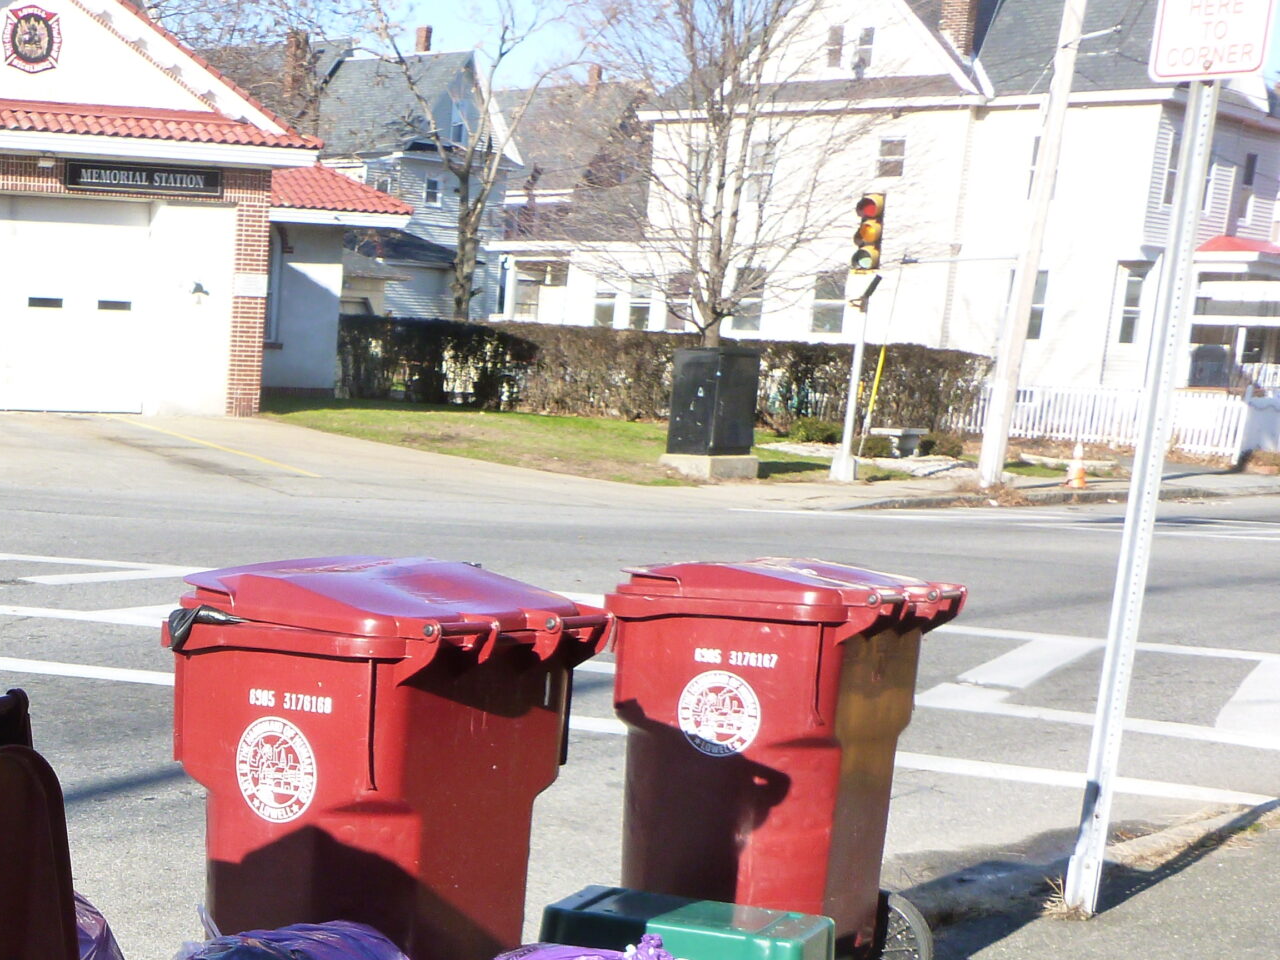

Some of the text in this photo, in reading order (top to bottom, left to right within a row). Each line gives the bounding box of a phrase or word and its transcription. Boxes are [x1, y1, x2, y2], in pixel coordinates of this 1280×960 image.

[1202, 20, 1228, 40] TO
[1167, 43, 1254, 67] CORNER
[80, 169, 205, 188] MEMORIAL STATION
